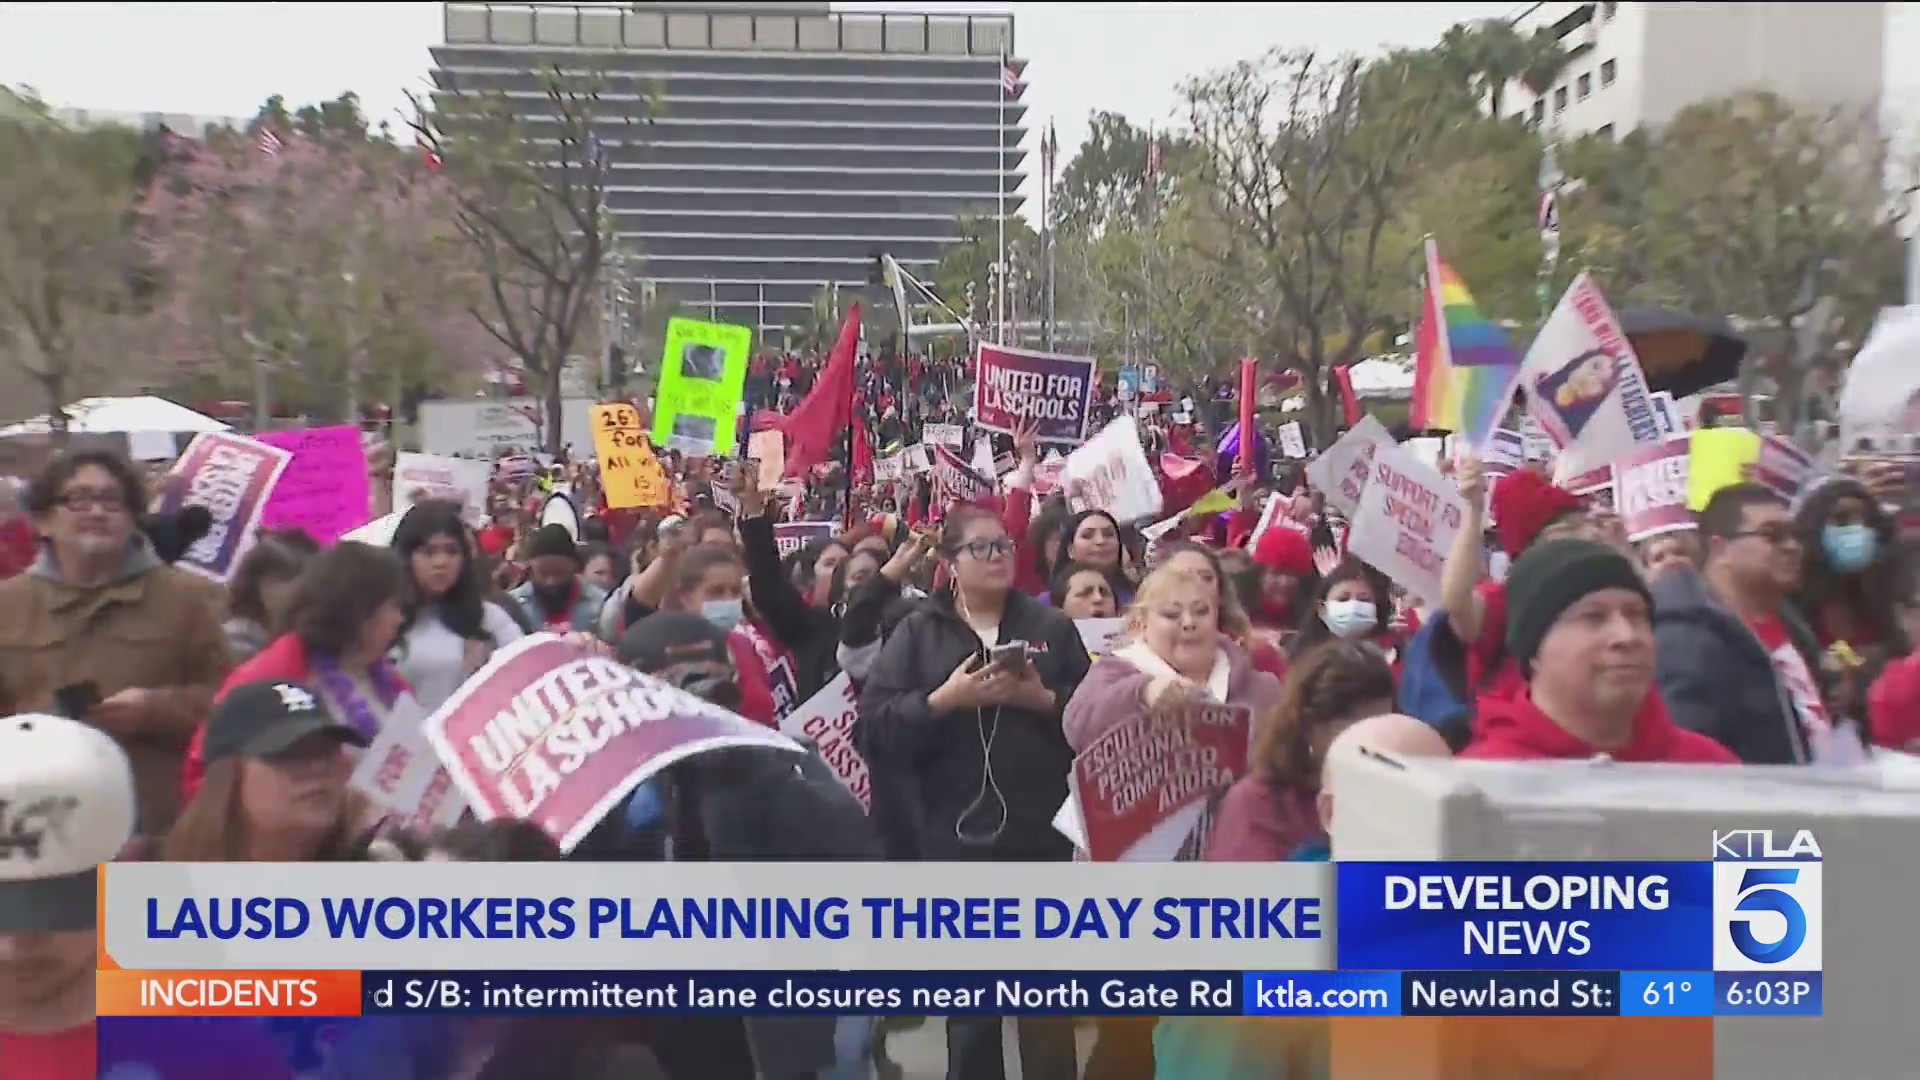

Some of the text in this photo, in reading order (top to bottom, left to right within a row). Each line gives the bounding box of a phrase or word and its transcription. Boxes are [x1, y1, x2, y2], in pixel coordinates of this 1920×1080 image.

[985, 363, 1083, 399] UNITED FOR
[469, 655, 633, 773] UNITED
[803, 715, 861, 779] CLASS
[1098, 727, 1194, 801] PERSONAL
